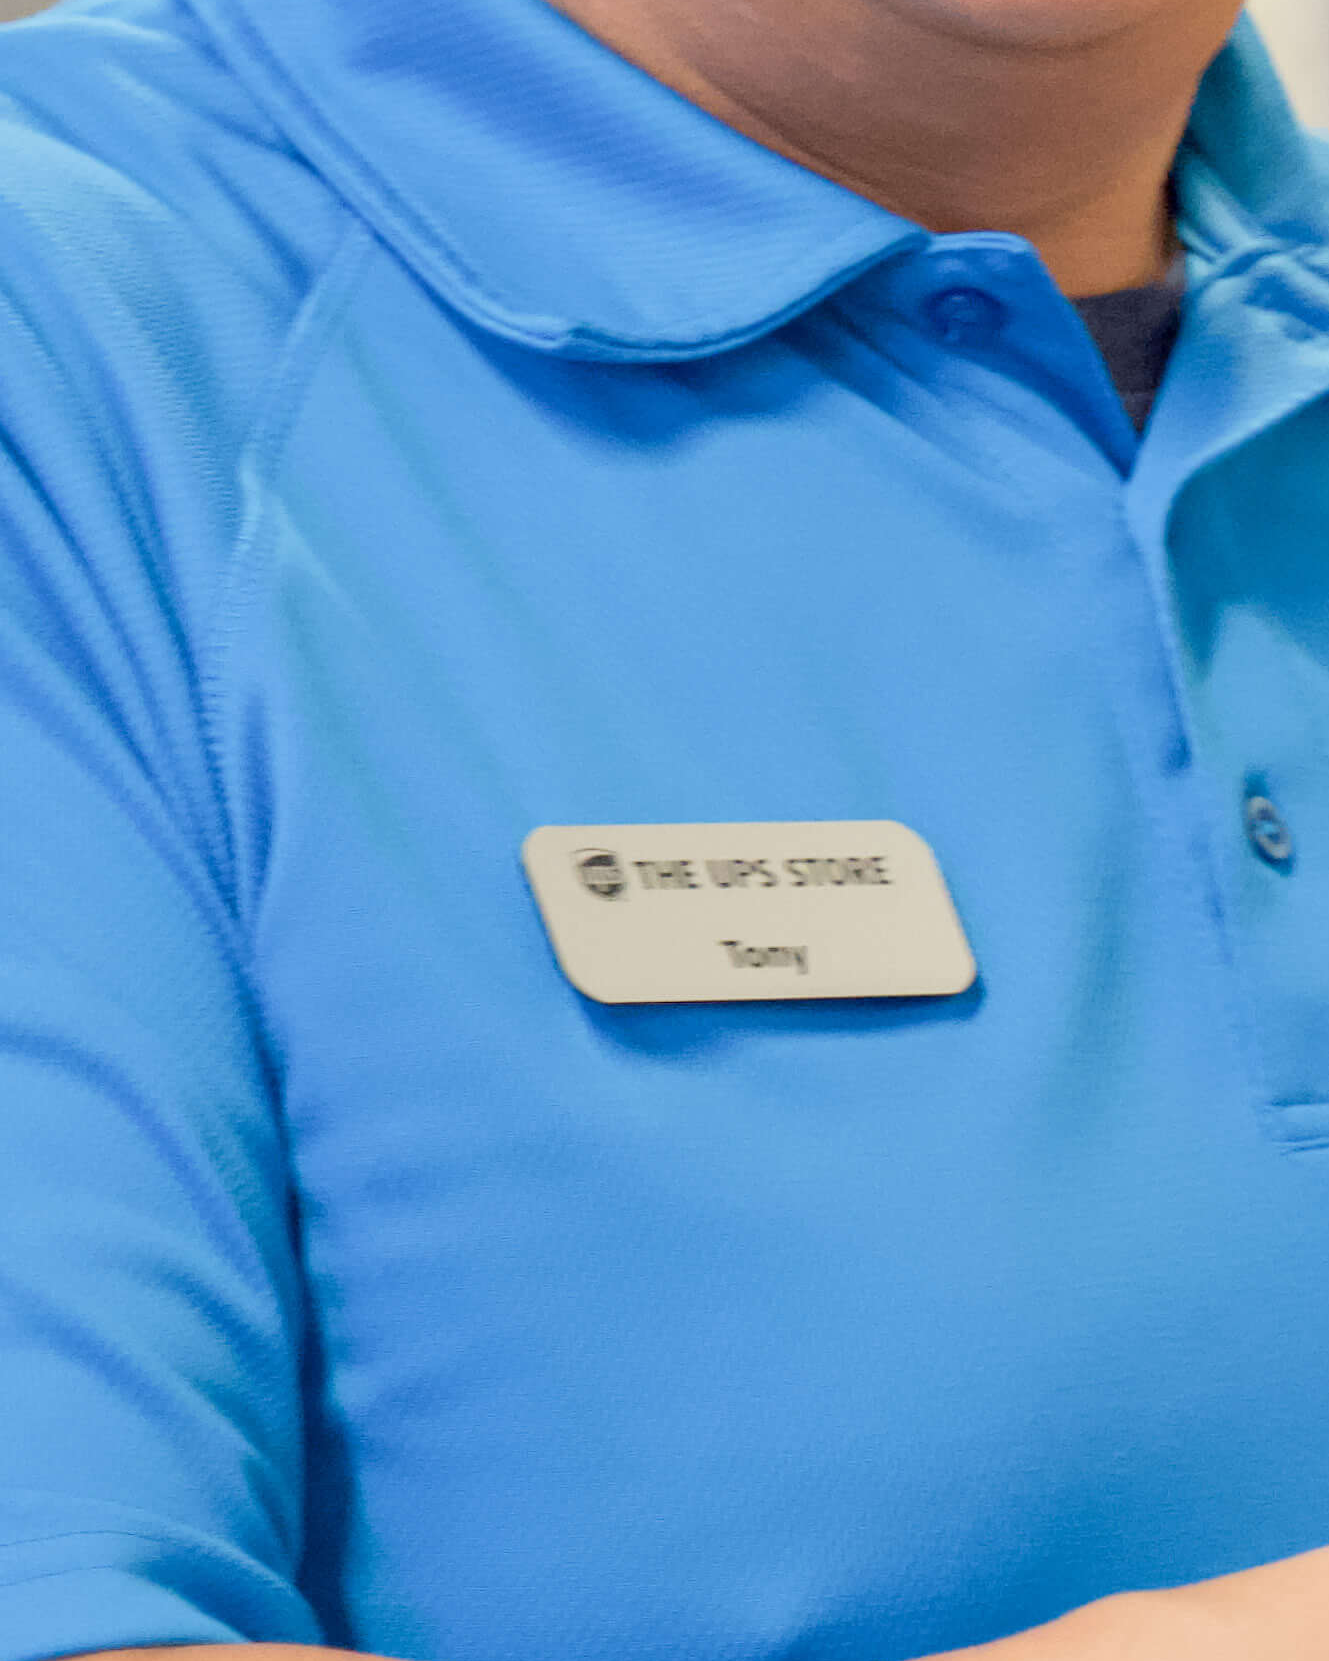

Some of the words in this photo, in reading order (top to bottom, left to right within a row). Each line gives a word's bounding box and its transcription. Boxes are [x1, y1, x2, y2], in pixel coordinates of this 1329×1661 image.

[632, 859, 702, 889] THE
[704, 858, 779, 888] UPS
[782, 855, 893, 887] STORE
[717, 939, 809, 975] Tony
